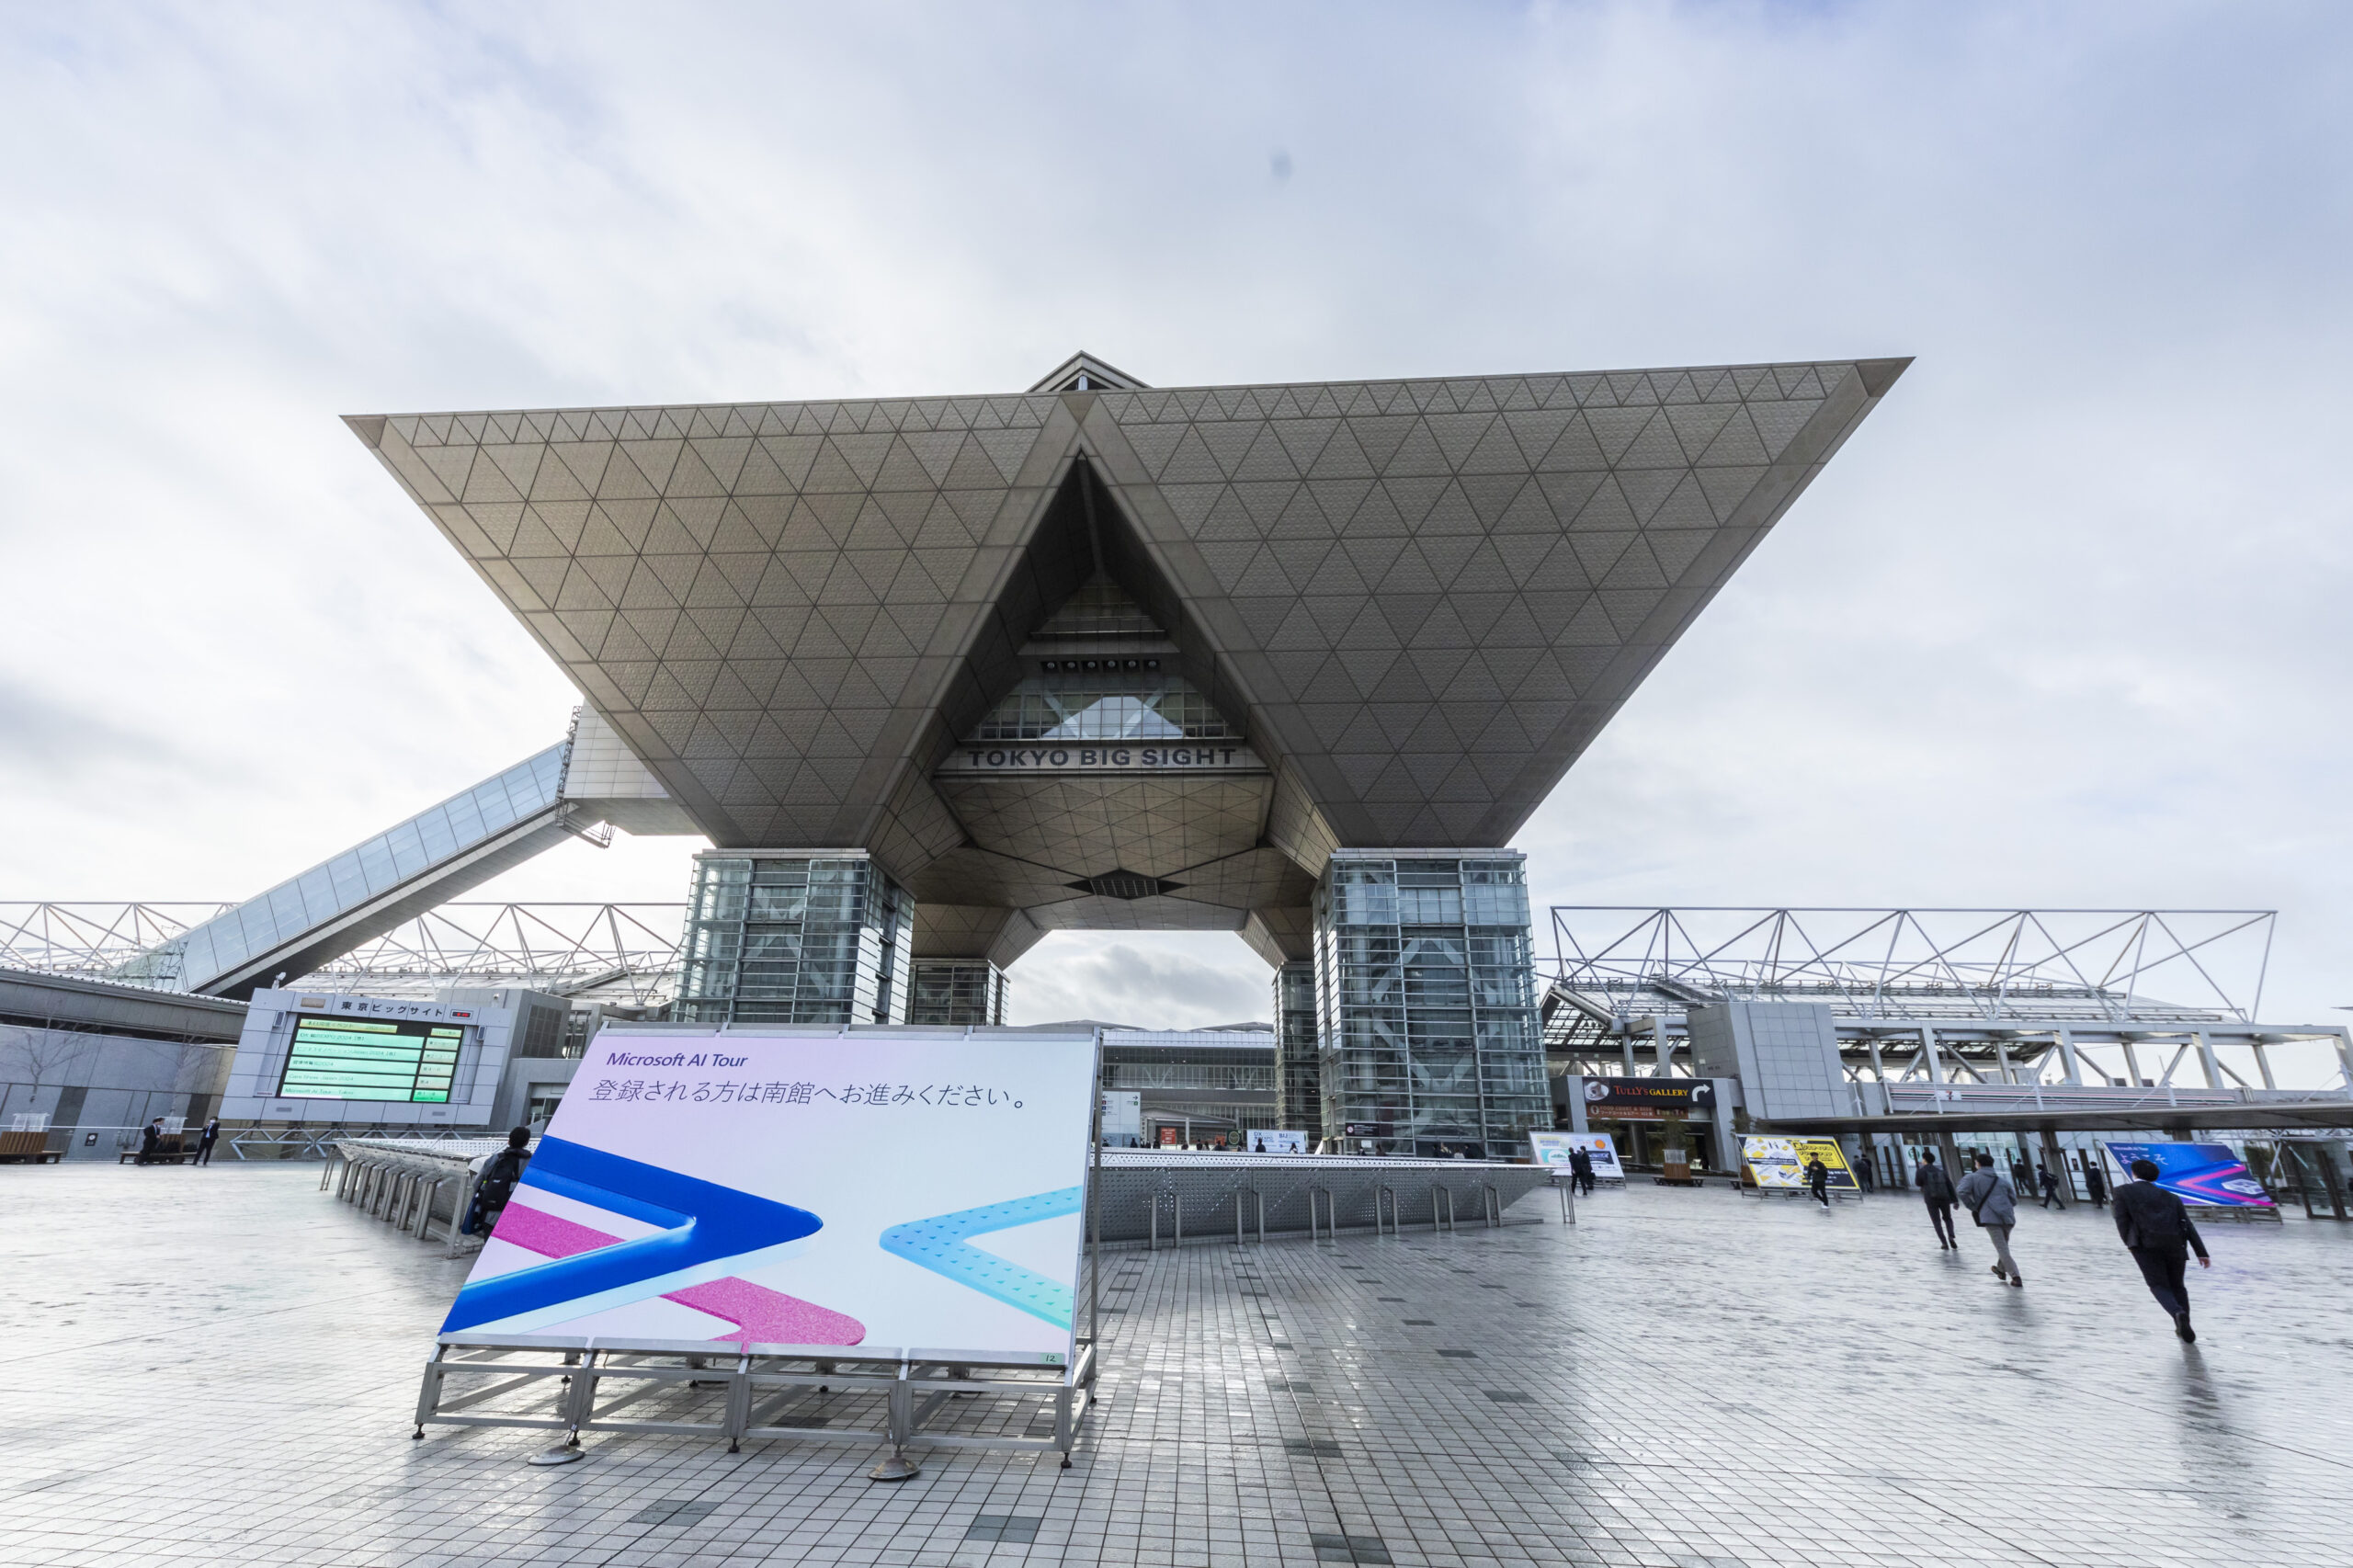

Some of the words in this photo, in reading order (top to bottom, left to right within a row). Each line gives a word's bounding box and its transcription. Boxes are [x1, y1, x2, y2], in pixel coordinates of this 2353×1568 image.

[967, 749, 1070, 767] TOKYO
[1080, 748, 1131, 766] BIG
[1141, 747, 1237, 766] SIGHT
[341, 1001, 442, 1017] 東京ビッグサイト
[607, 1052, 686, 1066] Microsoft
[687, 1053, 708, 1067] AI
[712, 1053, 748, 1067] Tour
[588, 1079, 1023, 1108] 登録される方は南館へお進みください。
[1649, 1088, 1688, 1096] GALLERY
[1045, 1354, 1058, 1363] 12
